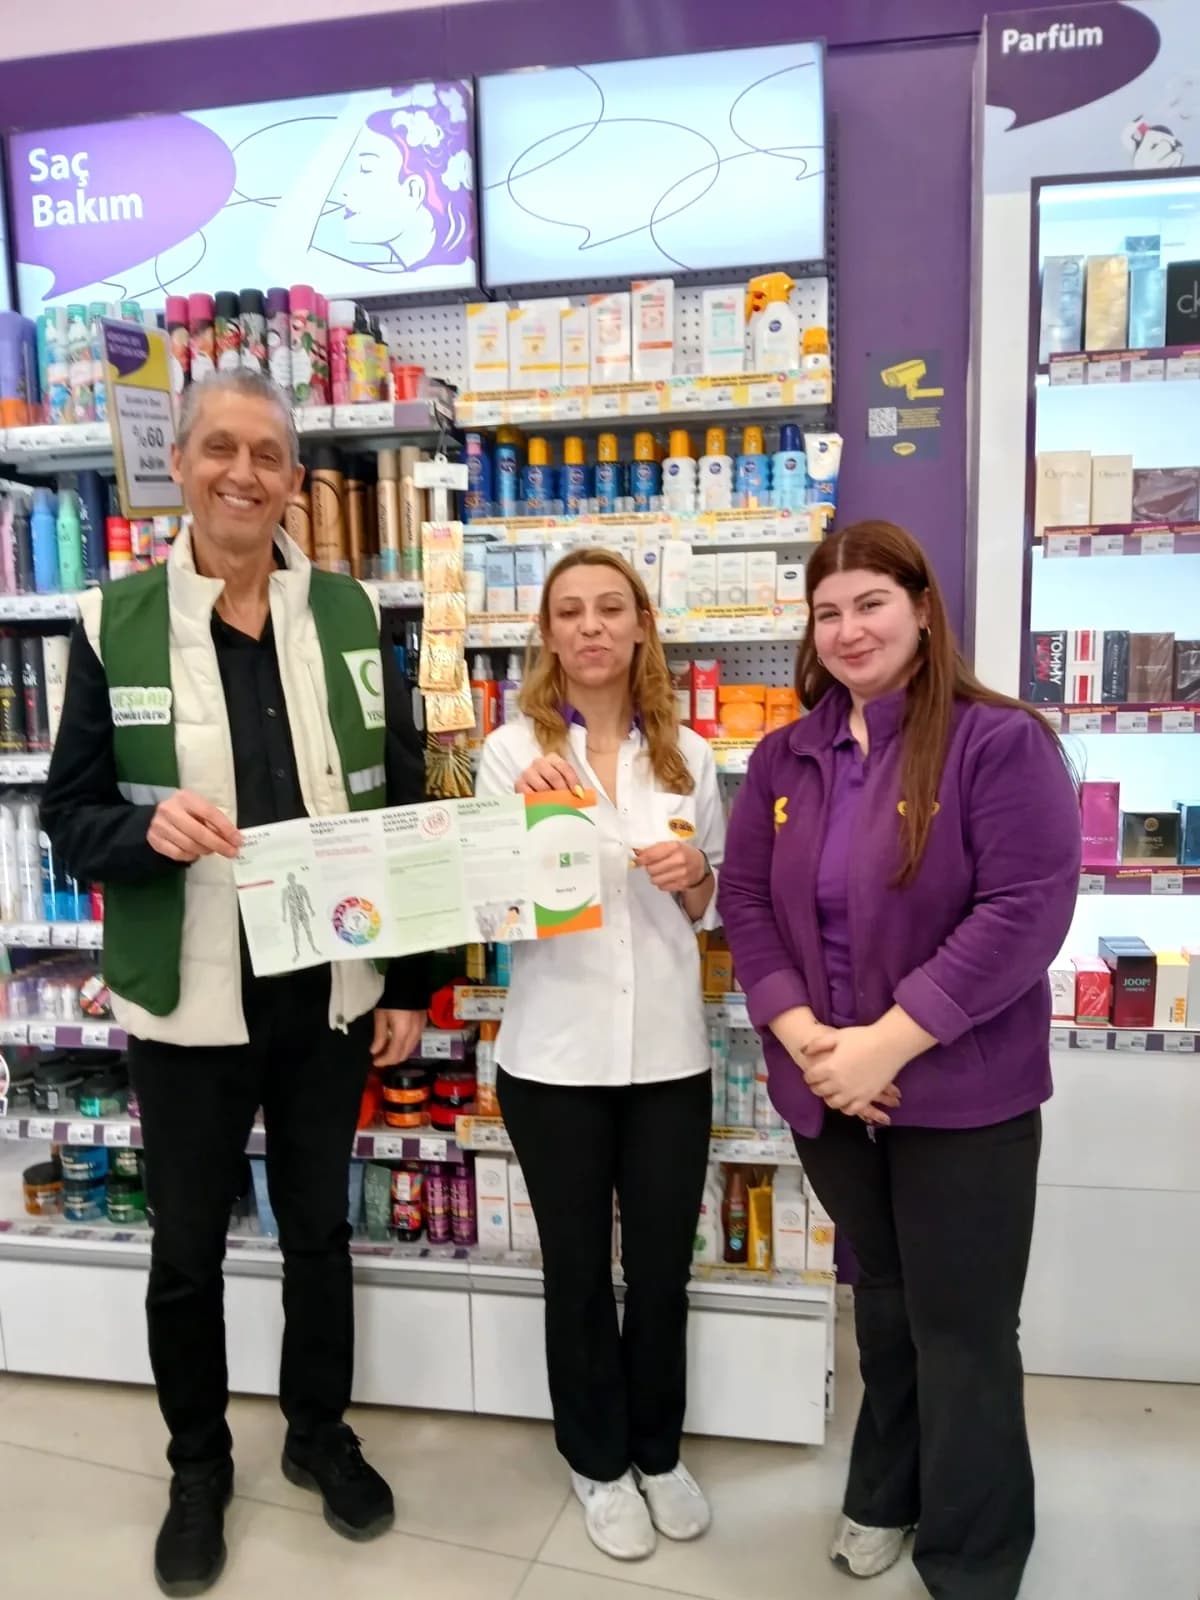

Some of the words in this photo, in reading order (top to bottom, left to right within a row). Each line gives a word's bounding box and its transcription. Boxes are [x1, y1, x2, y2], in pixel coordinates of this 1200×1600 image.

[1002, 22, 1103, 54] Parfüm
[28, 147, 90, 187] Saç
[31, 188, 144, 229] Bakım
[1048, 632, 1065, 686] TOMMY
[1122, 977, 1152, 987] JOOP!
[1174, 997, 1186, 1024] SUN
